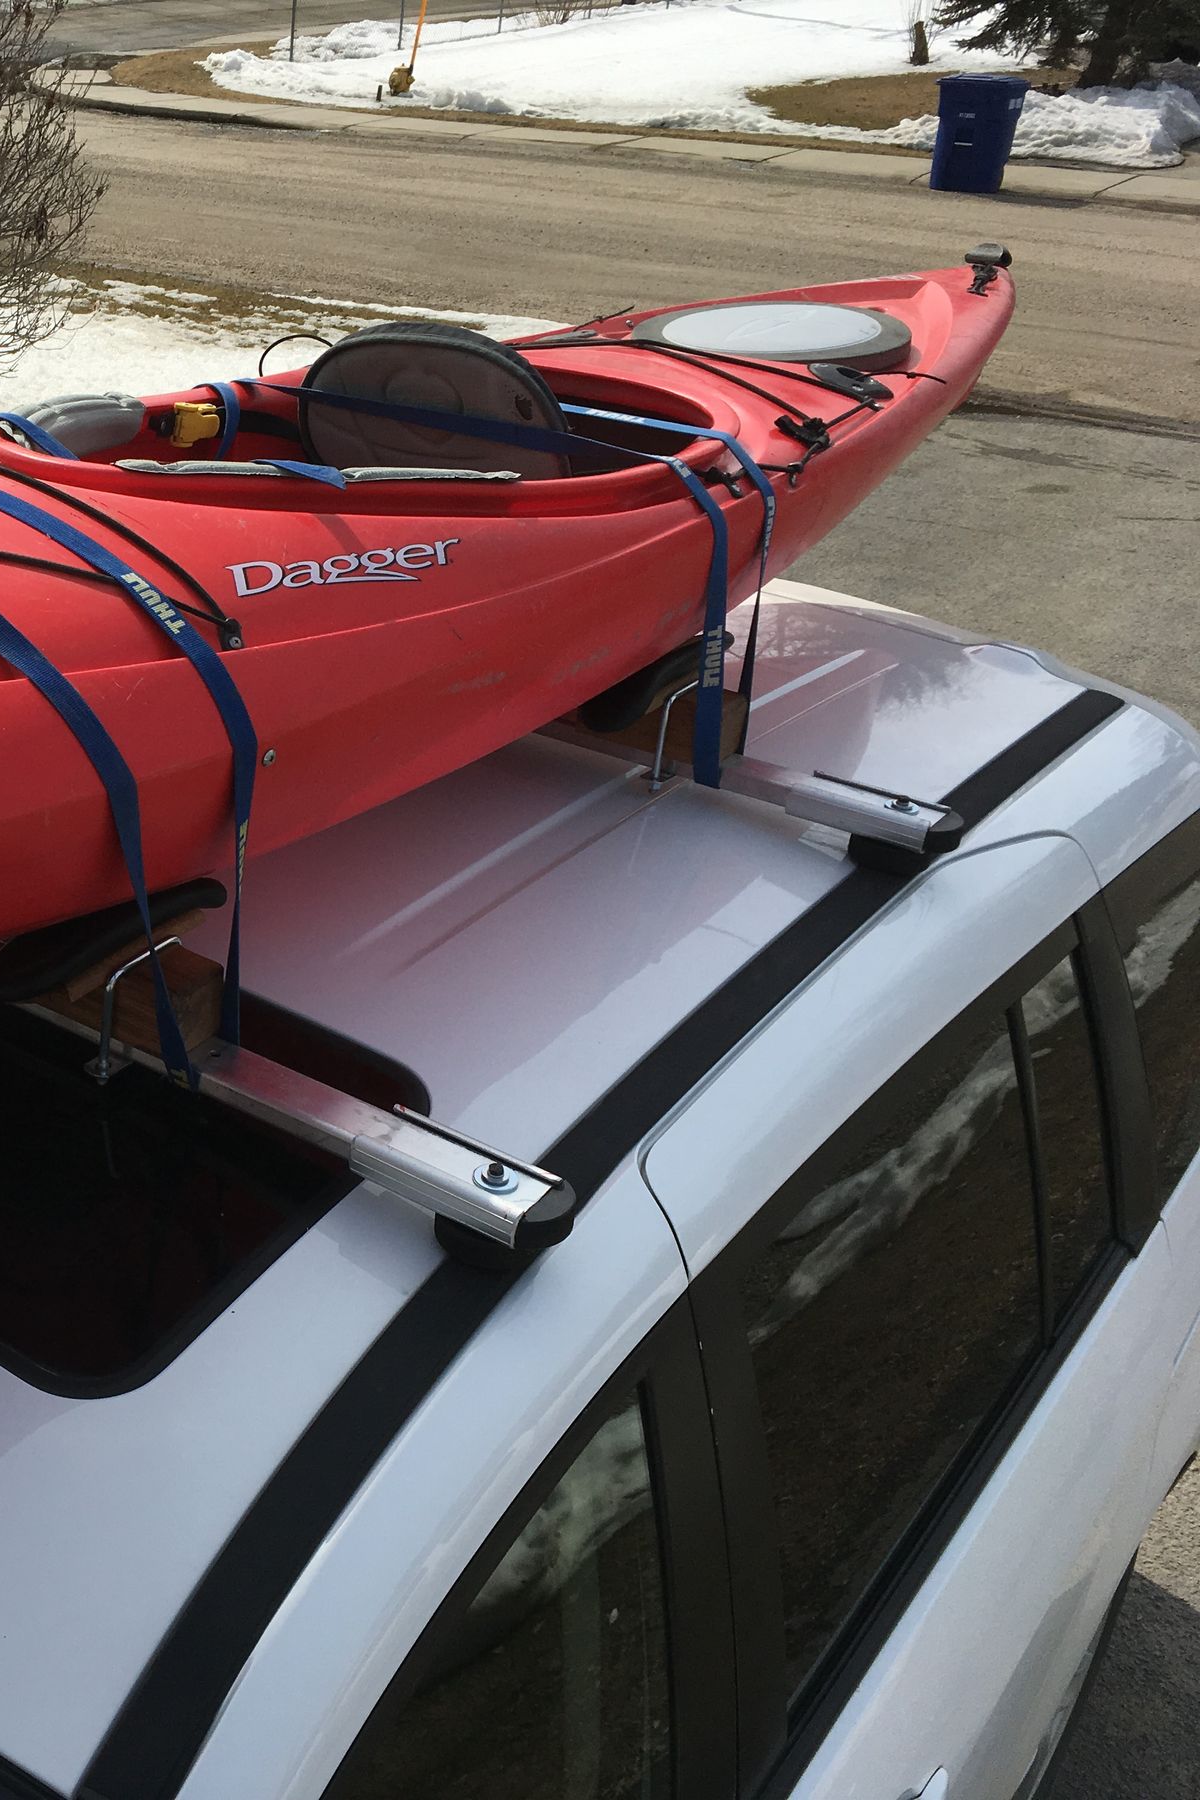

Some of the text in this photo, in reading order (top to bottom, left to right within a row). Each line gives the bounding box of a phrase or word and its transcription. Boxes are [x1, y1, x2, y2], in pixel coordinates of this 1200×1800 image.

[225, 538, 461, 597] Dagger
[120, 572, 186, 634] THULE
[702, 624, 723, 688] THULE
